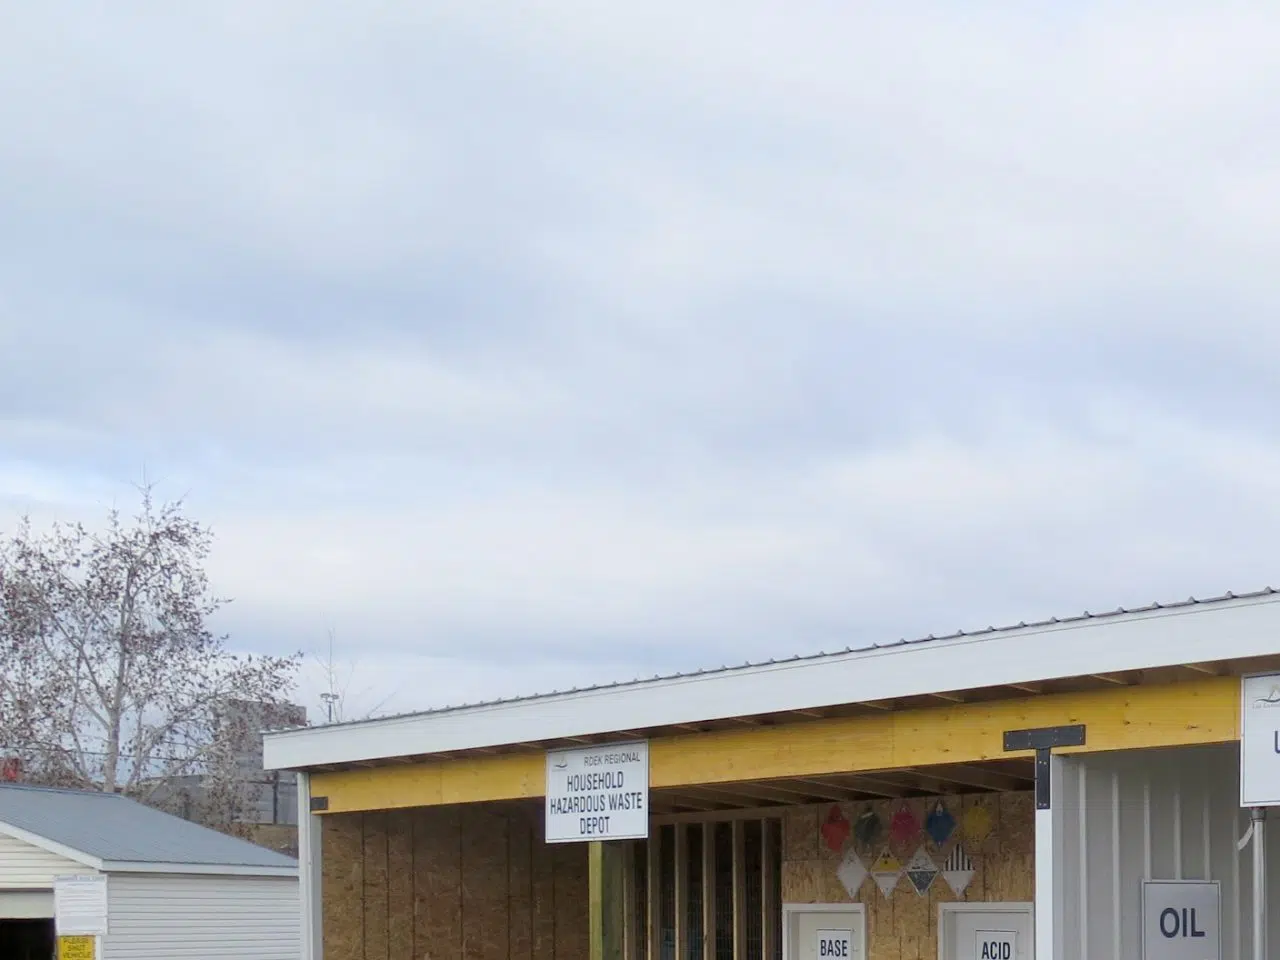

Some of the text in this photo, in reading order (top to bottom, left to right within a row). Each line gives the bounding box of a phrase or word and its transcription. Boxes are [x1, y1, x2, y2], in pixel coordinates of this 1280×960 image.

[584, 752, 641, 766] RDEK REGIONAL
[567, 771, 623, 792] HOUSEHOLD
[550, 792, 643, 815] HAZARDOUS WASTE
[579, 816, 610, 835] DEPOT
[1159, 907, 1206, 938] OIL
[820, 939, 848, 957] BASE
[981, 941, 1011, 960] ACID
